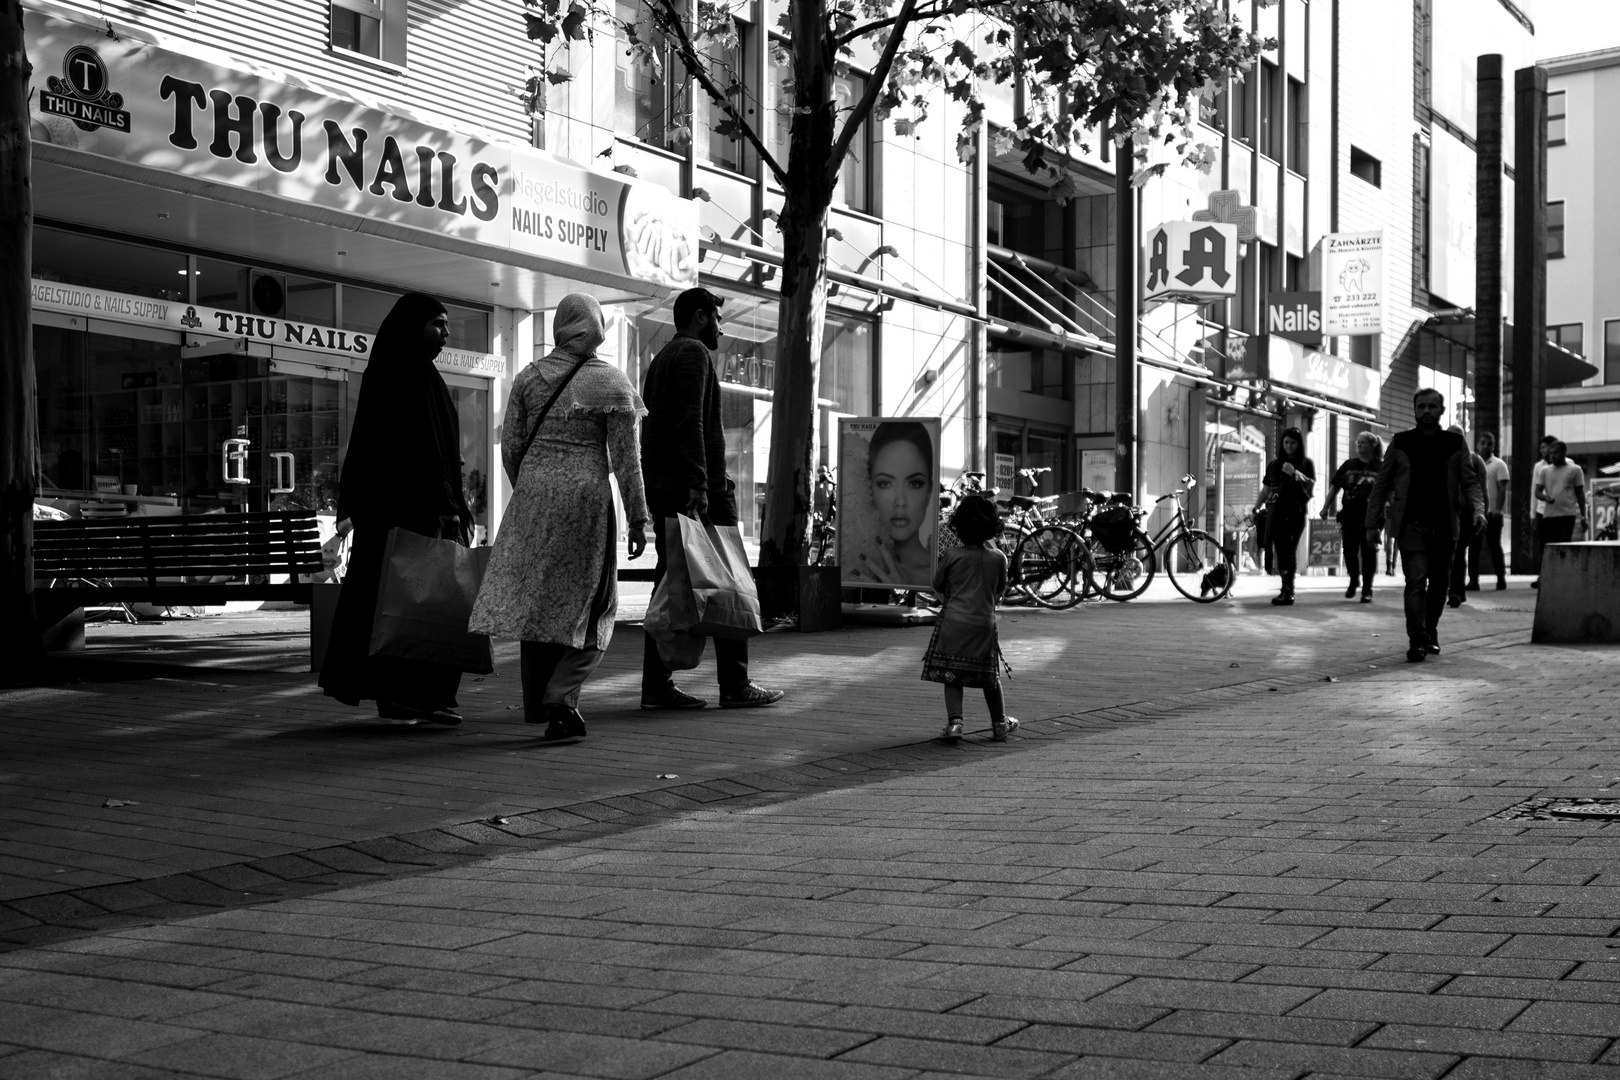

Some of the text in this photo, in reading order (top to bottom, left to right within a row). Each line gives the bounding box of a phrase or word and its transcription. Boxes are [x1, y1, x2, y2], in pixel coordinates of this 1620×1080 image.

[75, 58, 97, 91] T
[46, 96, 125, 128] THU NAILS
[159, 74, 499, 222] THU NAILS
[512, 169, 608, 217] Nagelstudio
[512, 206, 608, 253] NAILS SUPPLY
[93, 294, 102, 311] &
[104, 295, 131, 315] NAILS
[133, 300, 169, 321] SUPPLY
[1346, 292, 1377, 302] 233 222
[214, 311, 368, 354] THU NAILS
[1269, 303, 1321, 332] Nails
[453, 353, 459, 366] &
[460, 354, 480, 369] NAILS
[480, 357, 505, 374] SUPPLY
[400, 574, 479, 602] PRIMAR
